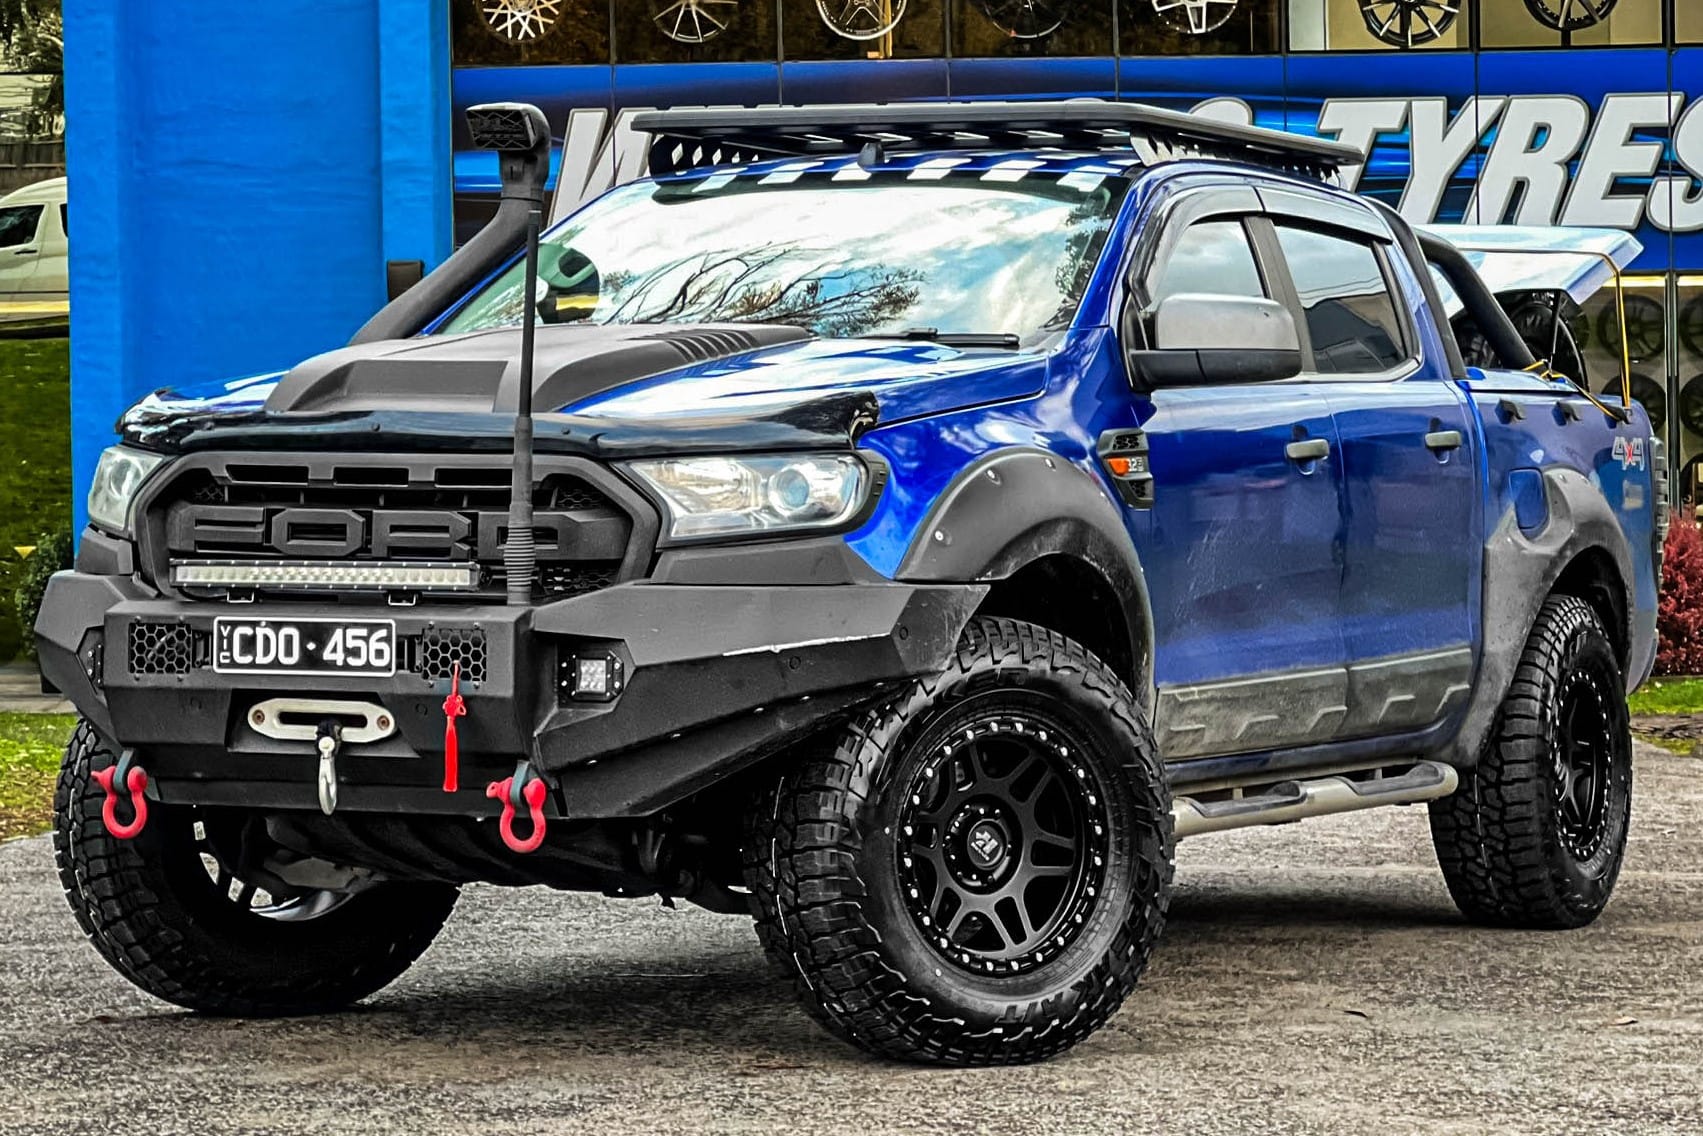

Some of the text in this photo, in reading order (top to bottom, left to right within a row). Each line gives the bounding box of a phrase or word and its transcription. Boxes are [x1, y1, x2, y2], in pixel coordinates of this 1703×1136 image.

[172, 503, 583, 560] FORD
[219, 625, 232, 664] VIC
[322, 628, 391, 667] 456
